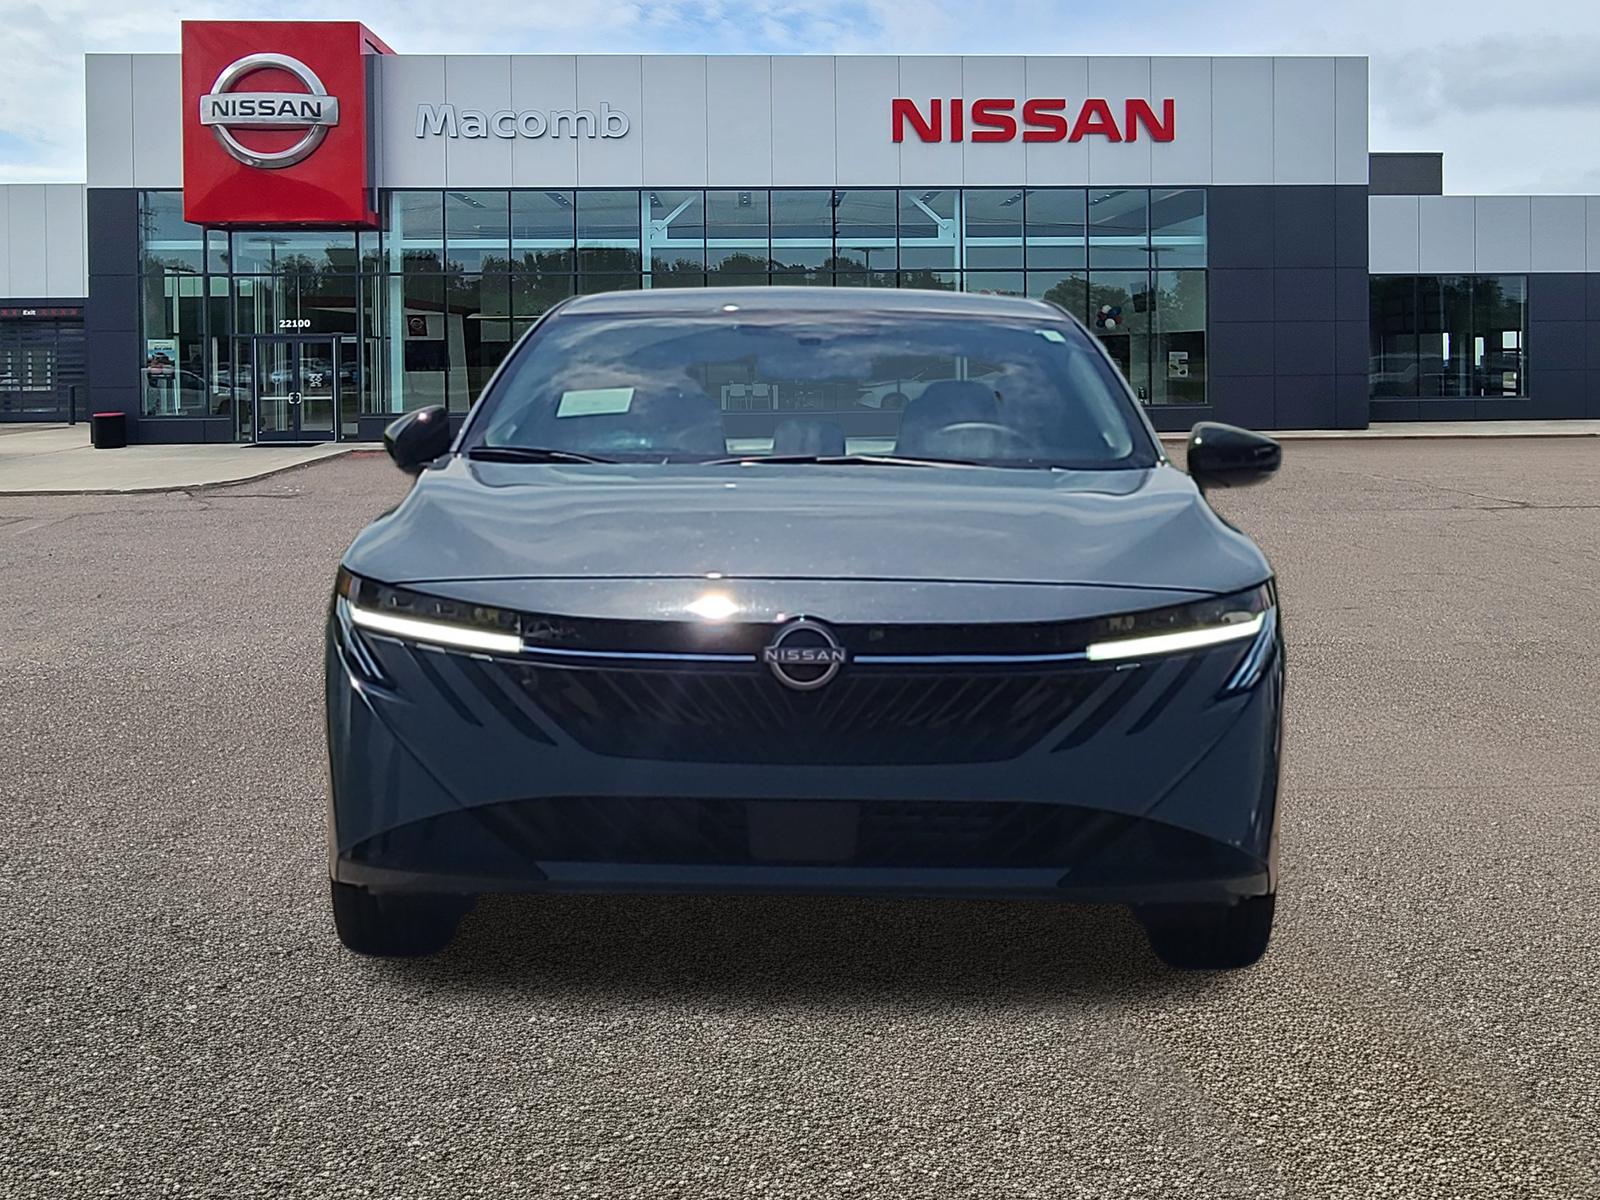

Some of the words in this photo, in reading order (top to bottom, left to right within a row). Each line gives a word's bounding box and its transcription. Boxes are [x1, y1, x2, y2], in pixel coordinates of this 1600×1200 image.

[211, 99, 323, 118] NISSAN
[415, 102, 630, 139] Macomb
[892, 98, 1176, 143] NISSAN
[279, 319, 311, 328] 22100
[764, 649, 845, 661] NISSAN
